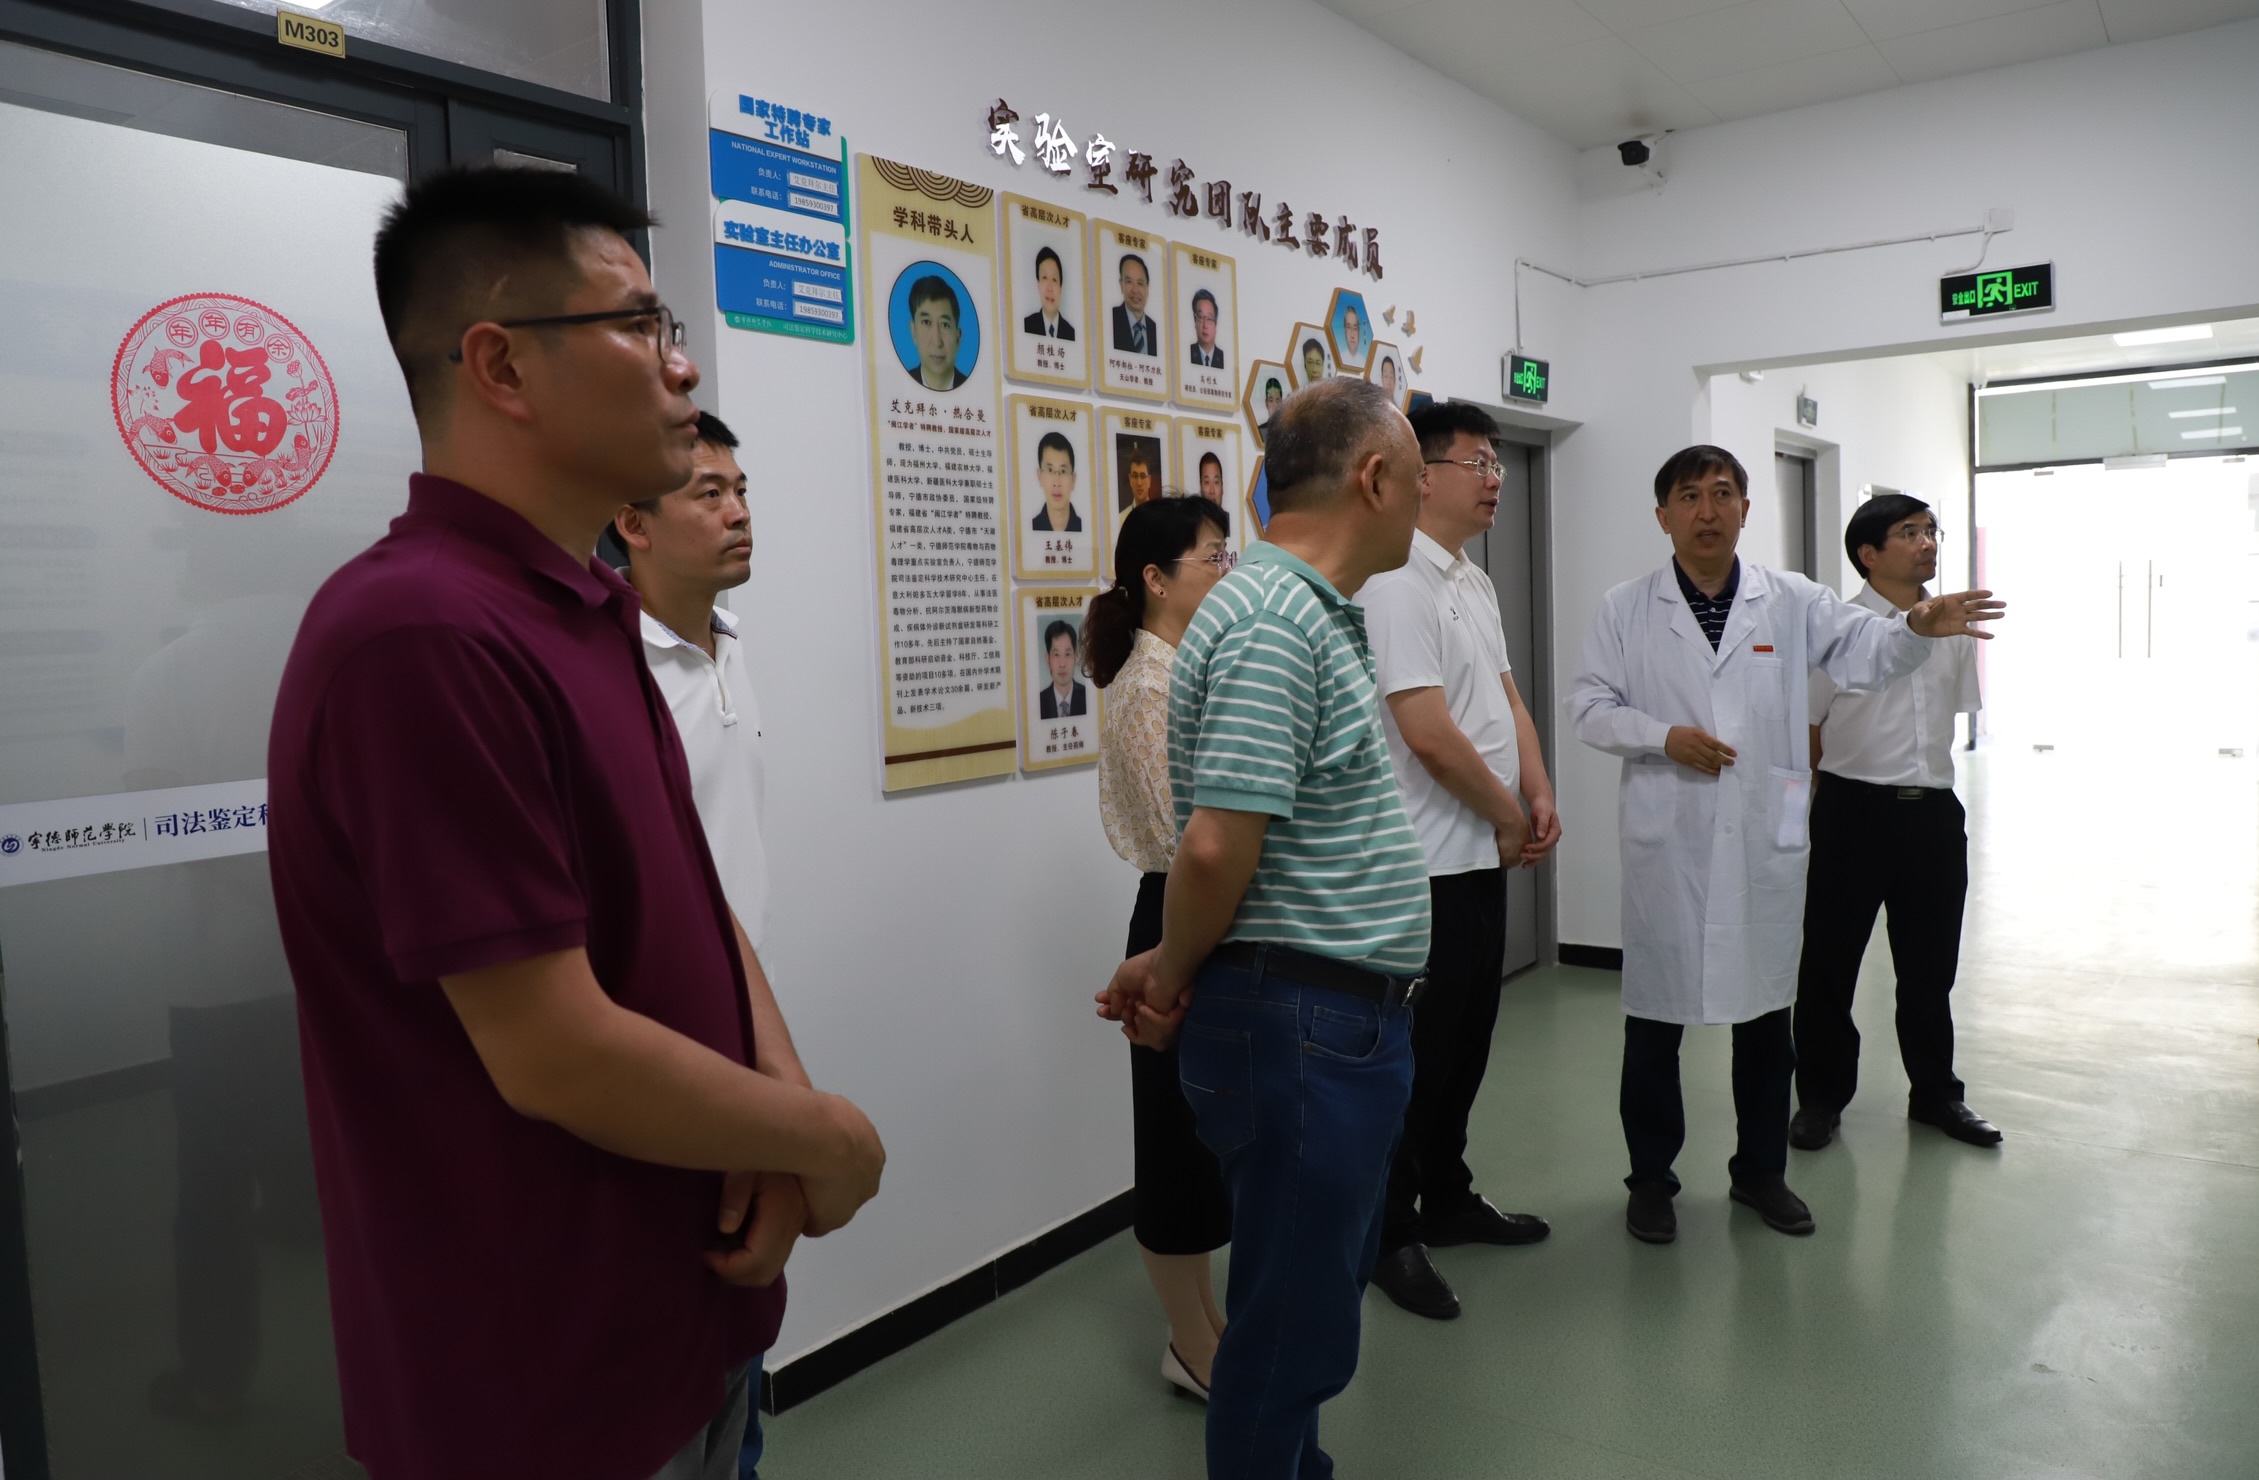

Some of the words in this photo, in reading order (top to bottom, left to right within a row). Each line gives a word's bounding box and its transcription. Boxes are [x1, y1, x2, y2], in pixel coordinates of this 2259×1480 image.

[285, 19, 339, 48] M303
[738, 93, 832, 136] 国家特聘专家
[764, 120, 810, 150] 工作站
[731, 140, 766, 156] NATIONAL
[766, 149, 791, 163] EXPERT
[791, 156, 837, 174] WORKSTATION
[987, 97, 1383, 280] 实验室研究团队主要成员
[724, 220, 841, 261] 实验室主任办公室
[893, 206, 974, 244] 学科带头人
[769, 259, 820, 277] ADMINISTRATOR
[820, 270, 841, 281] OFFICE
[2014, 281, 2039, 298] EXIT
[170, 314, 290, 357] 年年有余
[173, 339, 288, 457] 福
[1029, 404, 1077, 421] 省高层次人才
[1036, 595, 1084, 608] 省高层次人才
